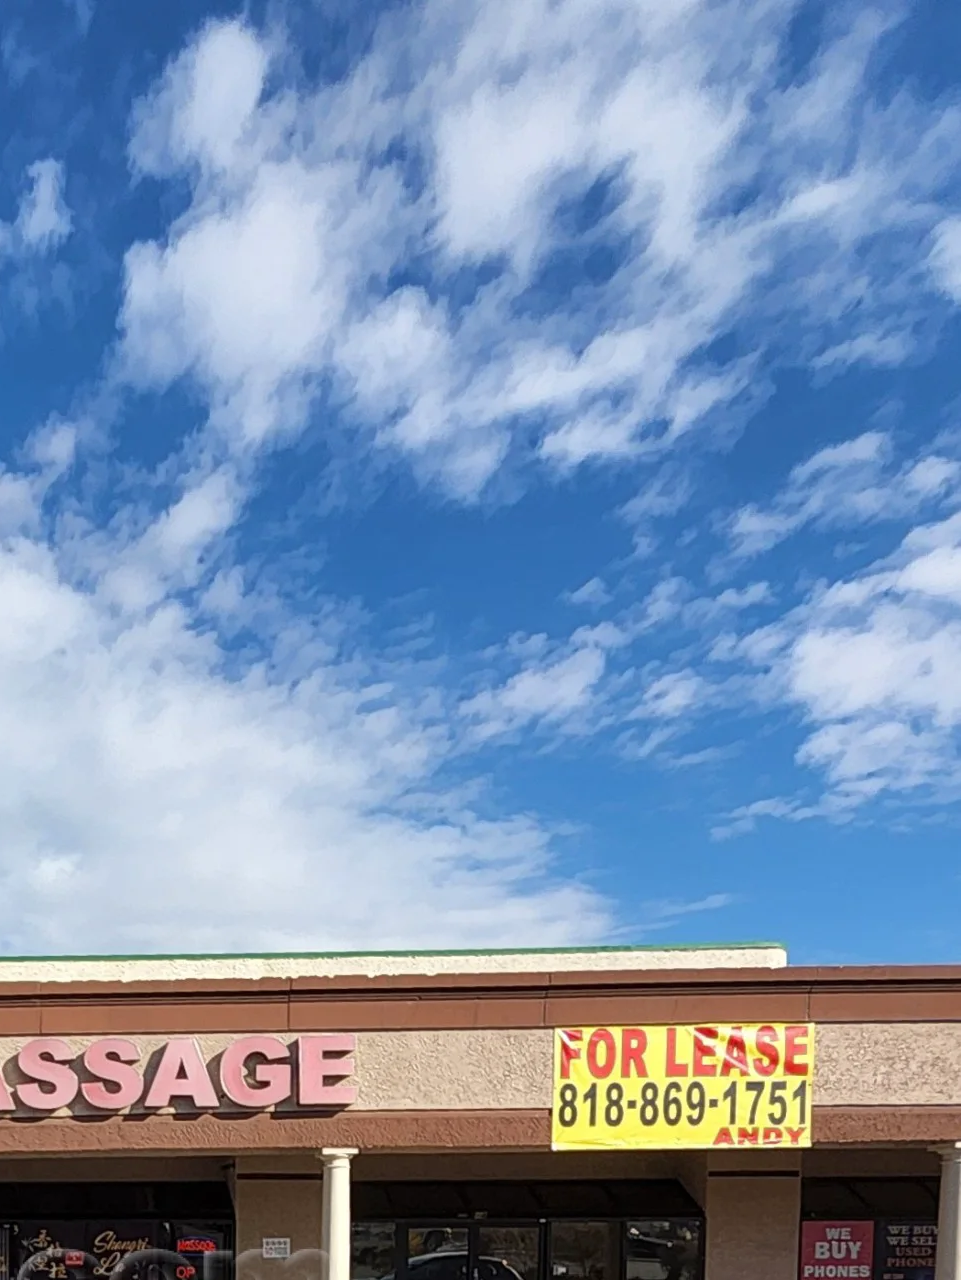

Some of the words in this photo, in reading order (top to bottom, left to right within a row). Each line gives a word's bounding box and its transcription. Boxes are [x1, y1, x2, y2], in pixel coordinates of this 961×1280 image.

[559, 1027, 648, 1080] FOR
[665, 1025, 809, 1078] LEASE
[558, 1080, 807, 1127] 818-869-1751
[712, 1127, 807, 1145] ANDY
[825, 1228, 851, 1240] WE
[888, 1226, 910, 1235] WE
[886, 1236, 908, 1246] WE
[911, 1236, 936, 1246] SEL
[815, 1241, 863, 1260] BUY
[896, 1247, 932, 1256] USED
[803, 1265, 870, 1277] PHONES
